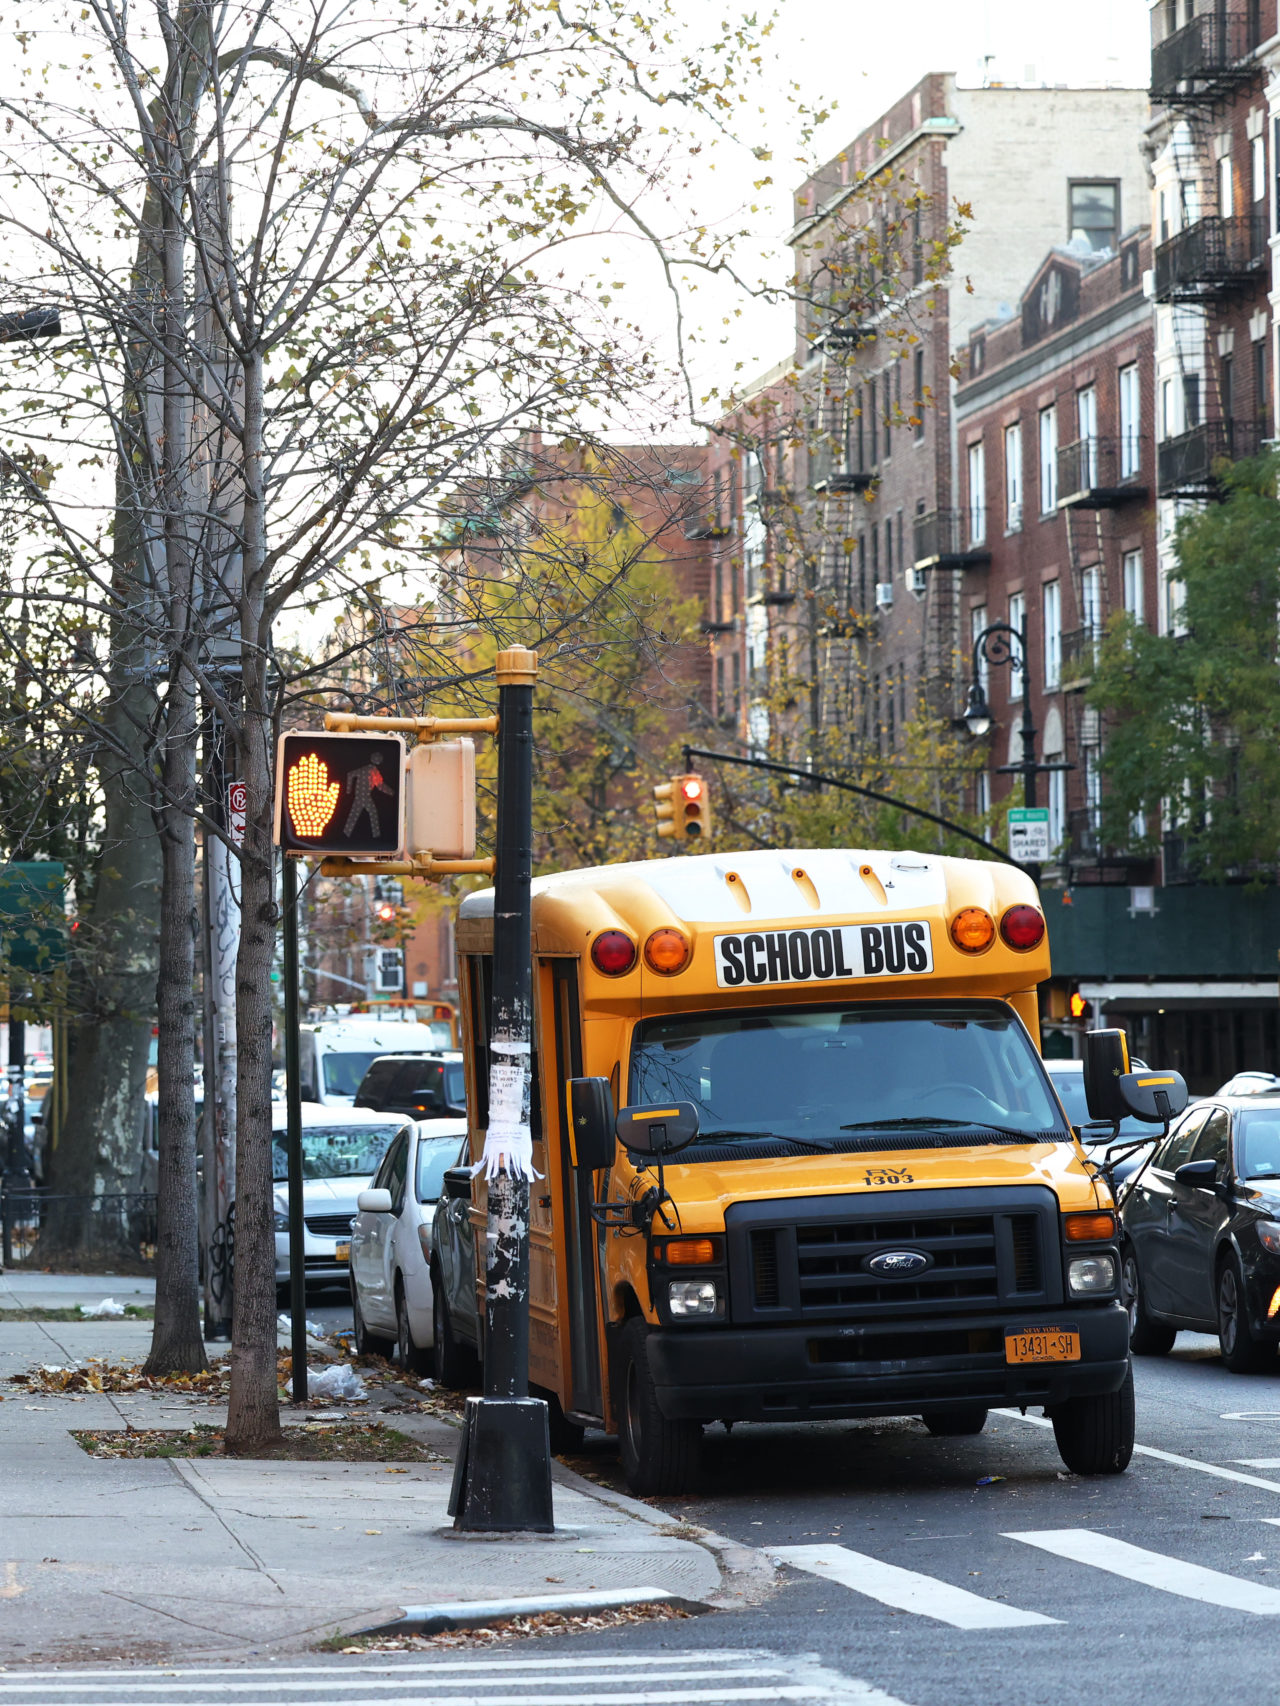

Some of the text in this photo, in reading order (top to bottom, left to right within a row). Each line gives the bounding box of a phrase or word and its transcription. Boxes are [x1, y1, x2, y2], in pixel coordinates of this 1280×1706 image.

[1018, 849, 1041, 857] LANE
[720, 923, 928, 986] SCHOOL BUS
[865, 1168, 907, 1176] RV
[862, 1175, 914, 1186] 1303
[883, 1255, 914, 1269] Ford
[1013, 1336, 1048, 1356] 13431
